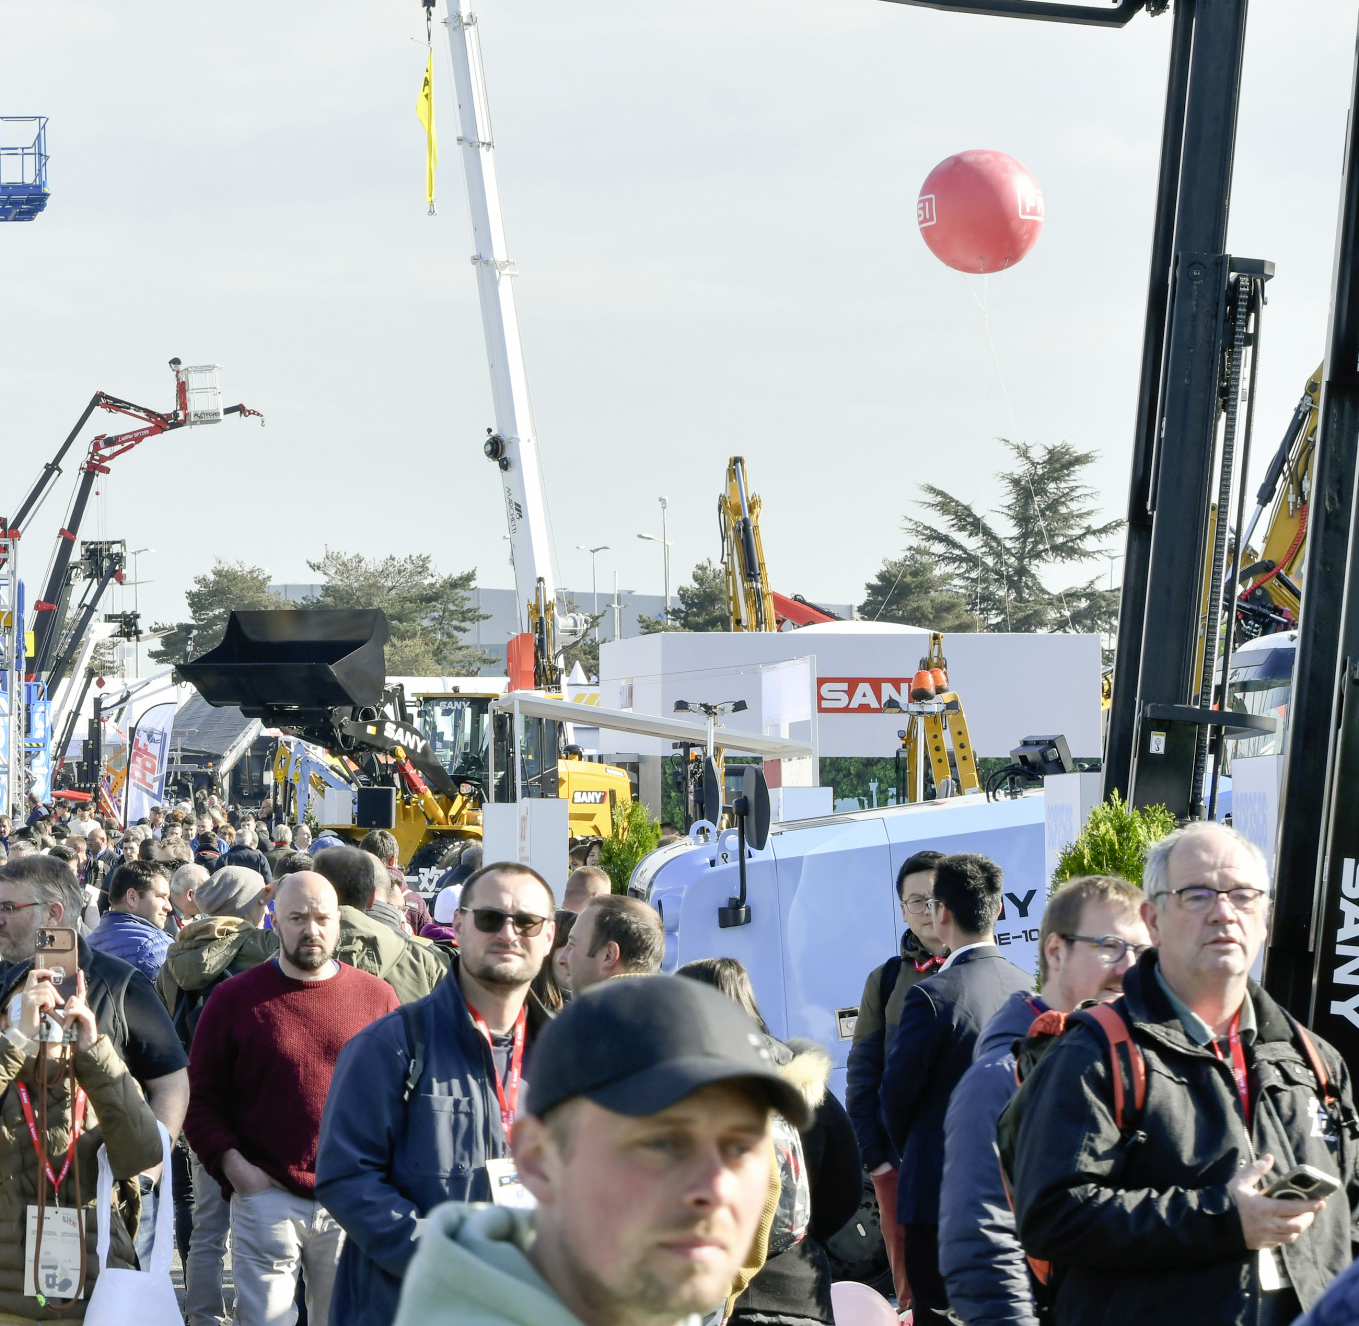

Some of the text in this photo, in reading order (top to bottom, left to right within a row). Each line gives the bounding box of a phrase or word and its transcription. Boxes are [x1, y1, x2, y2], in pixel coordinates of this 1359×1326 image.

[819, 682, 913, 709] SAN
[440, 701, 471, 710] SANY
[383, 721, 428, 754] SANY
[573, 791, 605, 803] SANY
